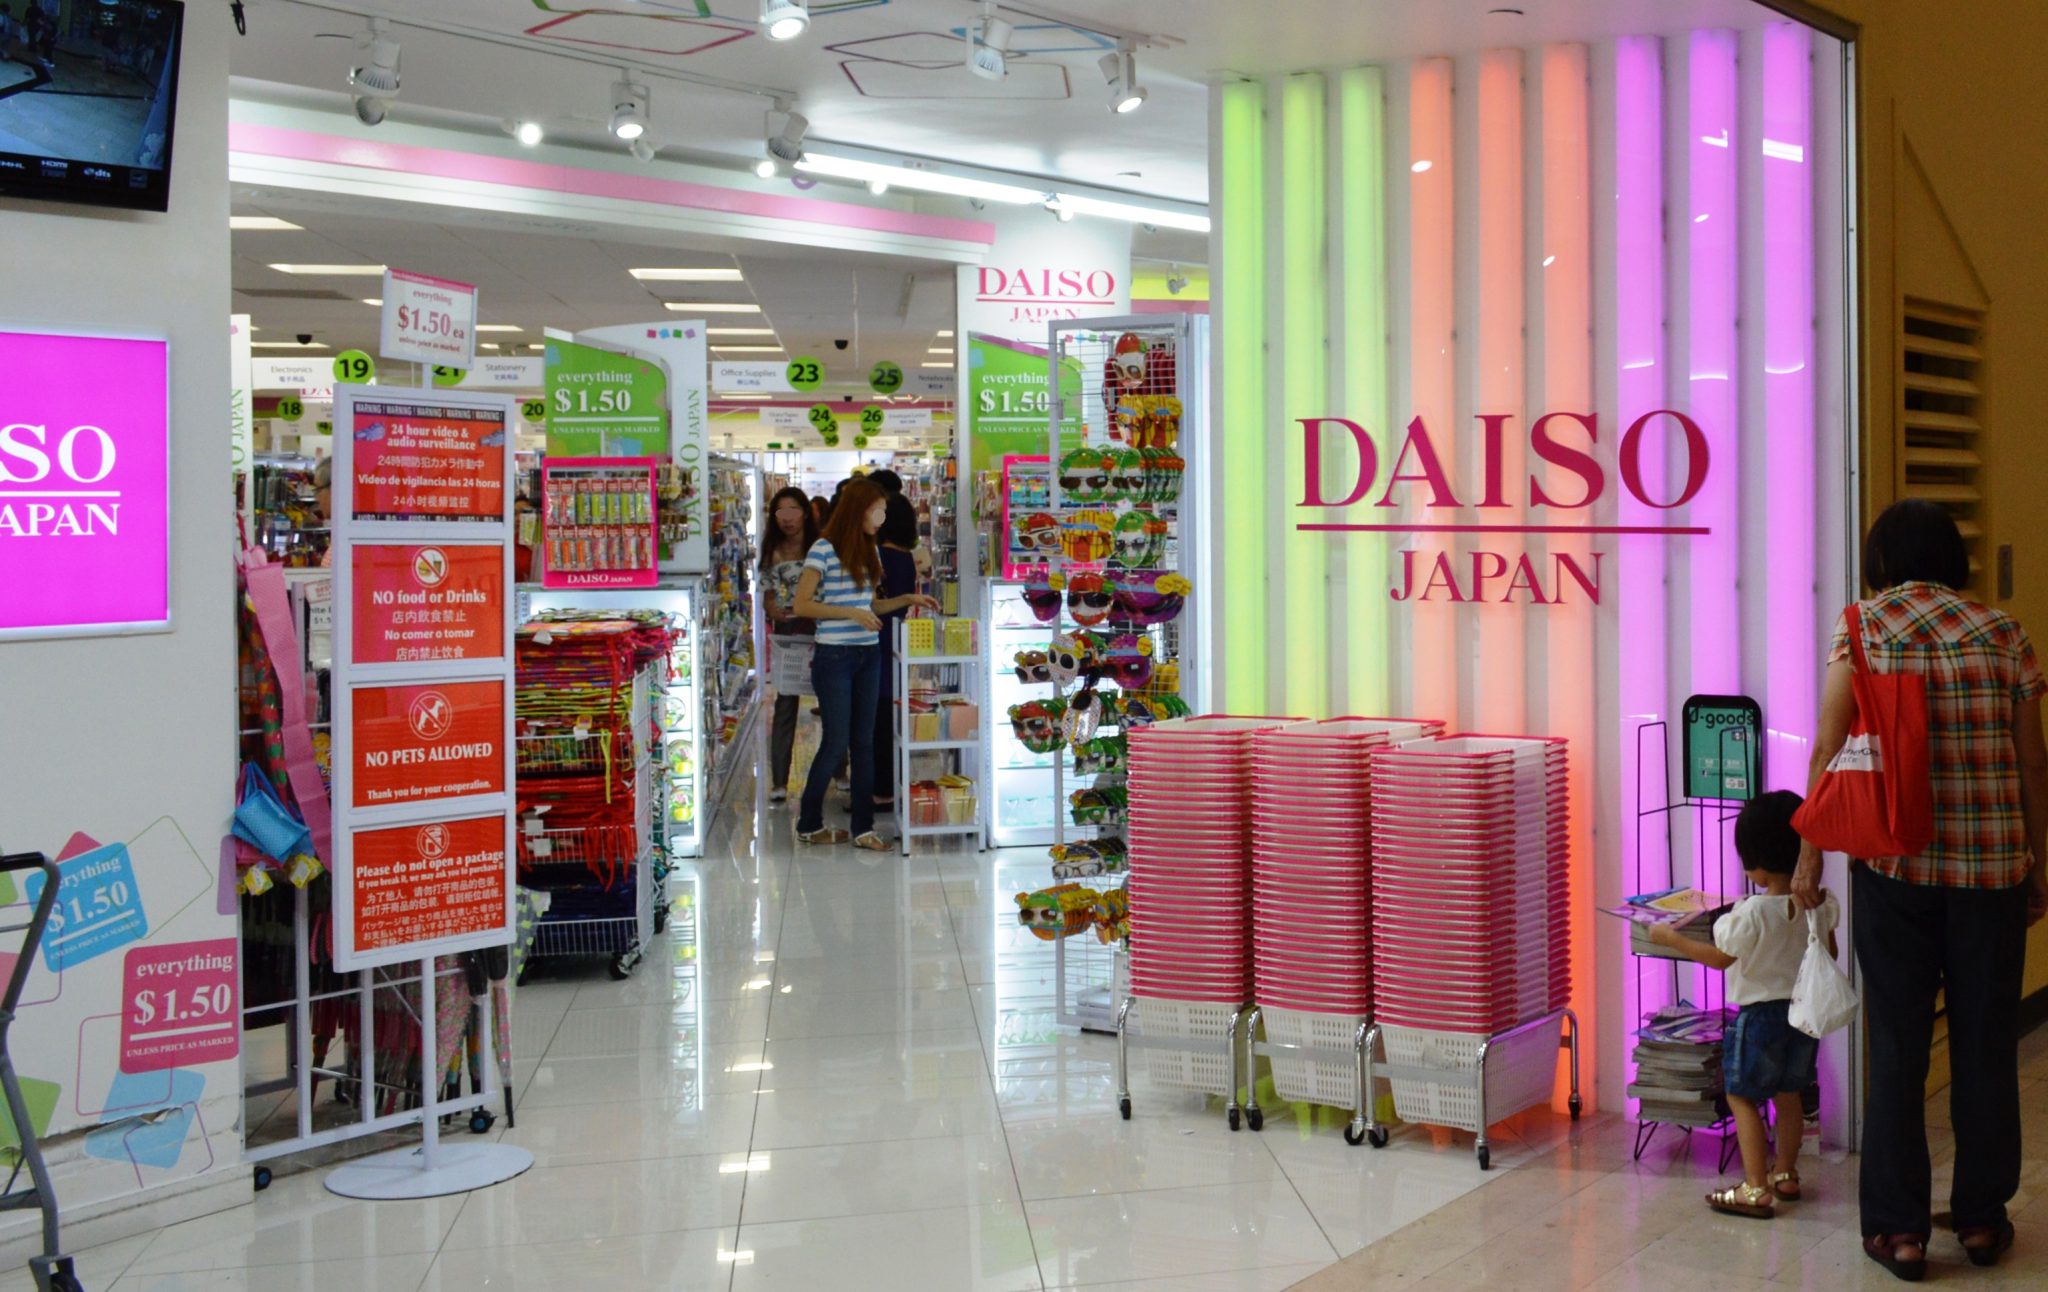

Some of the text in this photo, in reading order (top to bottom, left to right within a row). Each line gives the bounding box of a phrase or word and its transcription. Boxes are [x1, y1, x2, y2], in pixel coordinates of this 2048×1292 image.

[95, 168, 111, 178] dts
[977, 266, 1115, 298] DAISO
[412, 289, 453, 306] everything
[398, 303, 465, 340] $1.50 ea
[1010, 307, 1081, 323] JAPAN
[270, 365, 313, 374] Electronics
[339, 358, 369, 379] 19
[485, 364, 527, 373] Stationery
[720, 369, 776, 378] Office Supplies
[791, 363, 820, 383] 23
[557, 370, 633, 385] everything
[873, 368, 899, 386] 25
[982, 372, 1050, 387] everything
[554, 387, 631, 413] $1.50
[980, 388, 1049, 414] $1.50
[282, 401, 303, 416] 18
[355, 404, 381, 414] WARNING
[386, 405, 412, 416] WARNING
[417, 407, 442, 418] WARNING
[447, 409, 471, 419] WARNING
[475, 410, 500, 420] WARNING
[524, 403, 544, 416] 20
[688, 389, 700, 438] JAPAN
[811, 408, 830, 422] 24
[863, 409, 882, 422] 26
[391, 424, 469, 438] 24 hour video &
[553, 426, 585, 434] UNLESS
[387, 436, 476, 450] audio surveillance
[1294, 408, 1710, 510] DAISO
[358, 474, 501, 489] Video de vigilancia las 24 horas
[567, 574, 610, 584] DAISO
[1390, 550, 1606, 606] JAPAN
[373, 589, 487, 605] NO food or Drinks
[392, 610, 467, 625] 店内飲食禁止
[384, 629, 475, 641] No comer o tomar
[365, 742, 493, 768] NO PETS ALLOWED
[367, 779, 491, 800] Thank you for your cooperation.
[356, 850, 504, 879] Please do not open a package
[366, 880, 379, 890] you
[380, 876, 400, 887] break
[420, 872, 434, 882] may
[435, 870, 447, 880] ask
[447, 869, 460, 880] you
[469, 863, 498, 877] purchase
[47, 880, 129, 933] $1.50
[136, 953, 233, 978] everything
[133, 983, 232, 1026] $1.50
[126, 1035, 235, 1058] UNLESS PRICE AS MARKED
